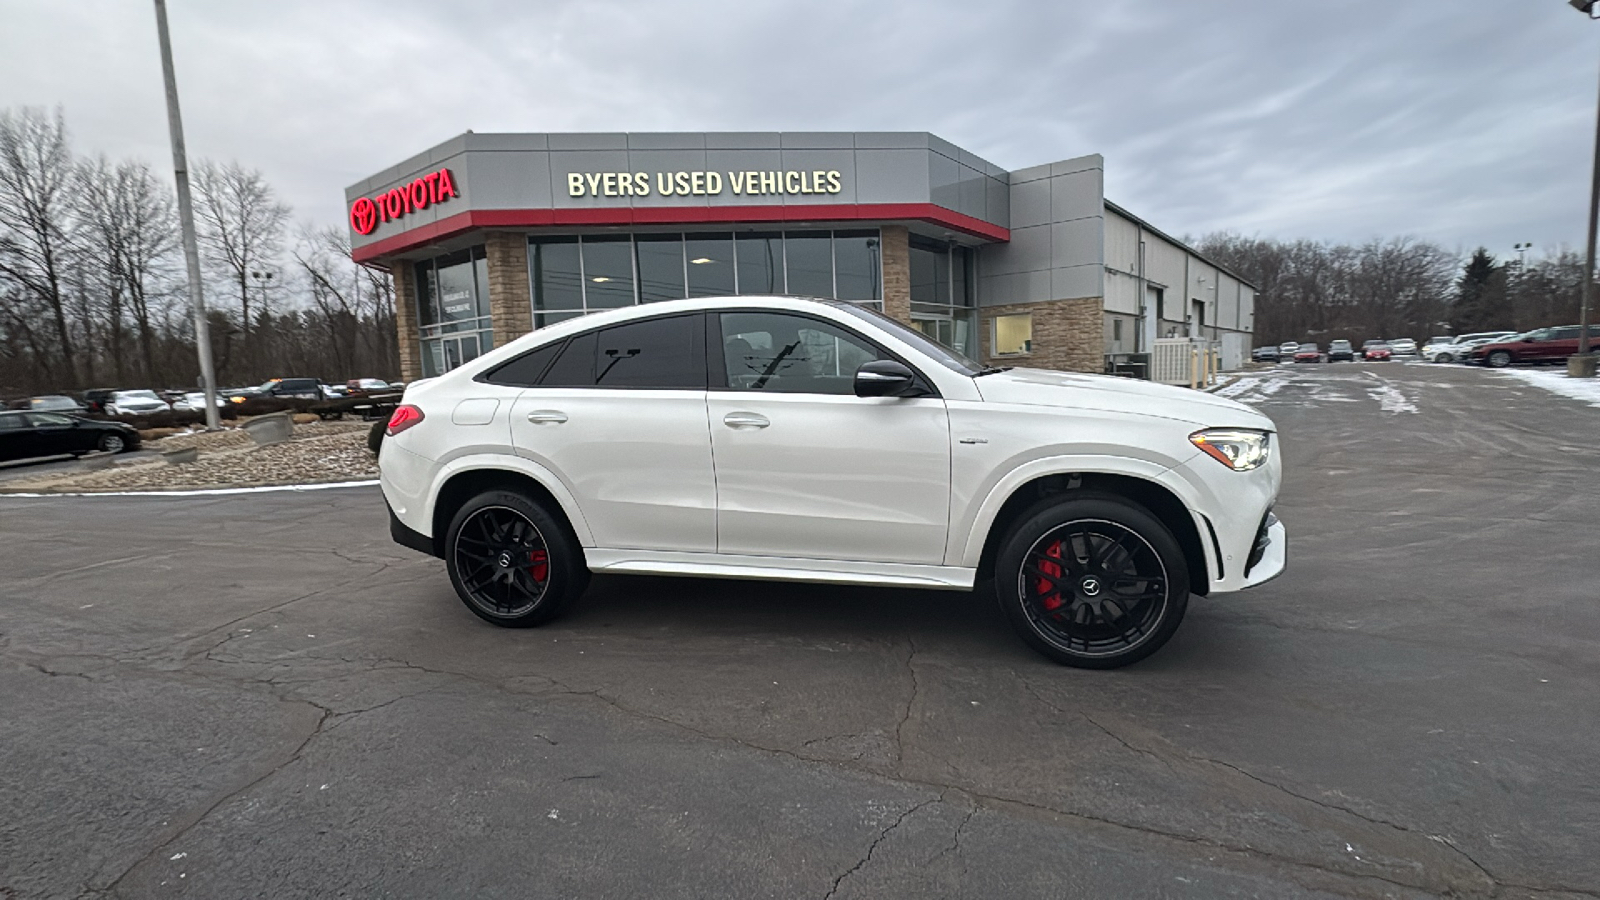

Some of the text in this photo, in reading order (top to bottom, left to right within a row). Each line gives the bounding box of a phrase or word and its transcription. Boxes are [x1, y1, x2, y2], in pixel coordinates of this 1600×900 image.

[375, 168, 456, 222] TOYOTA
[567, 170, 841, 196] BYERS USED VEHICLES
